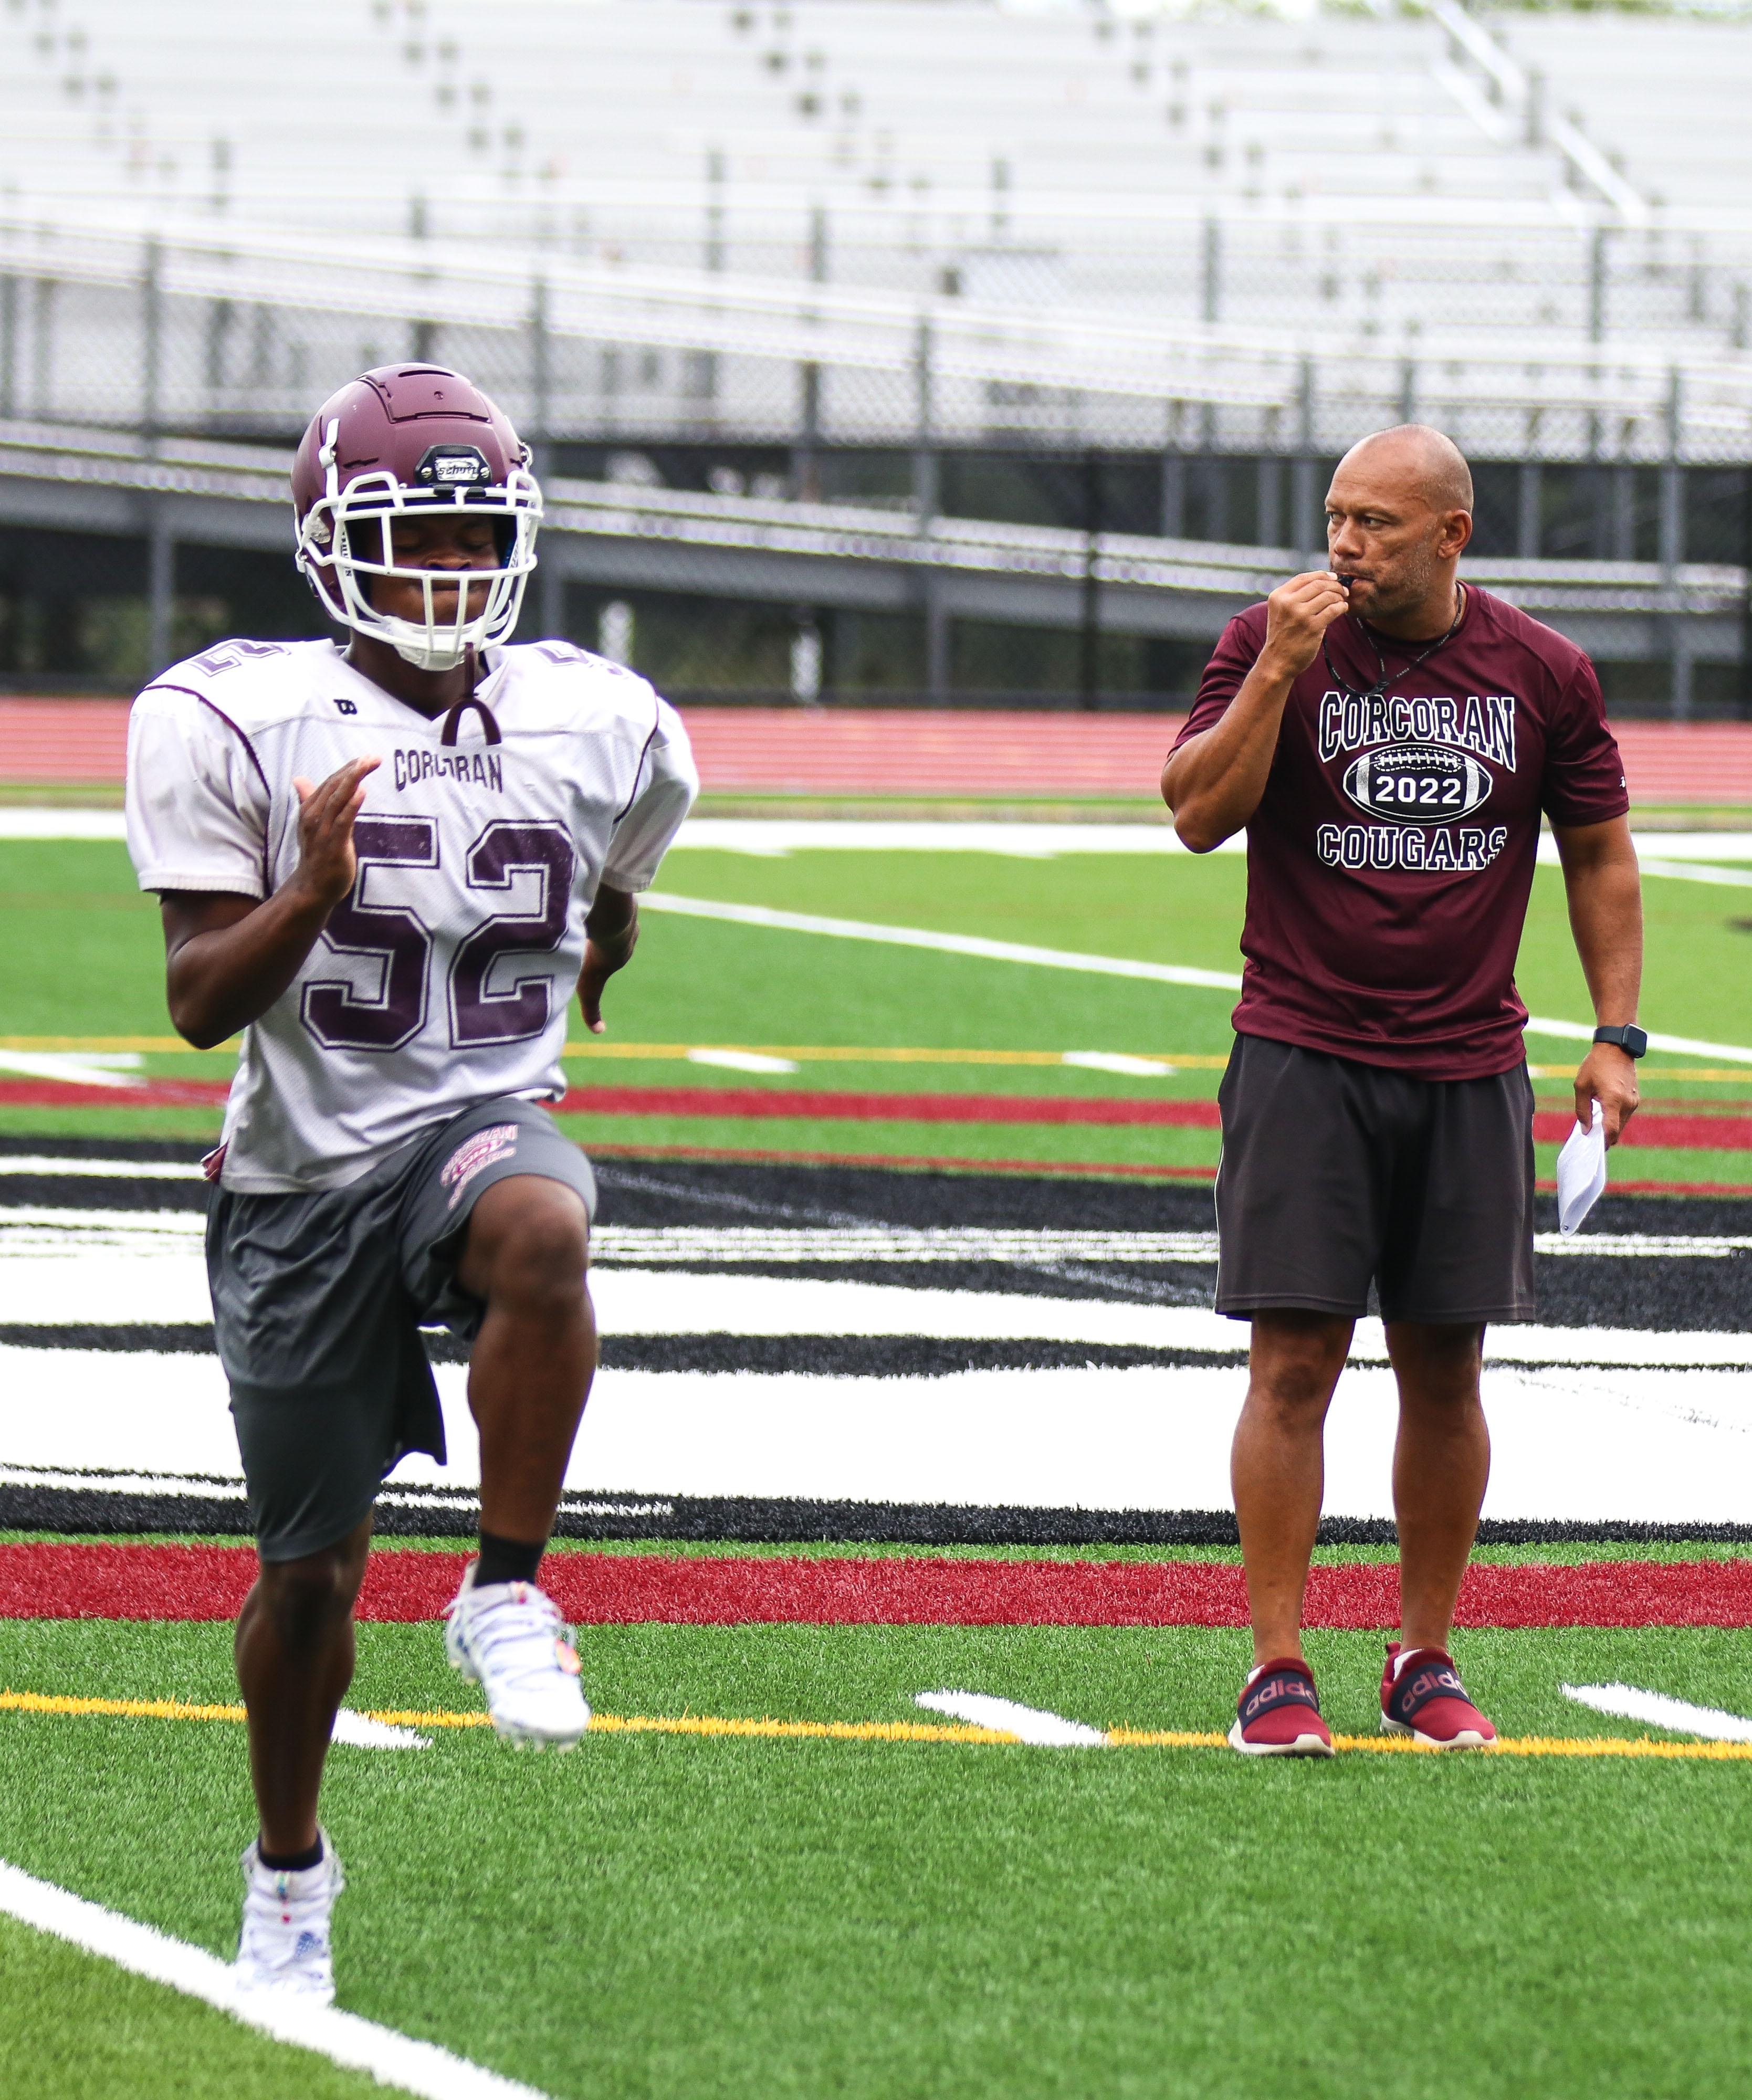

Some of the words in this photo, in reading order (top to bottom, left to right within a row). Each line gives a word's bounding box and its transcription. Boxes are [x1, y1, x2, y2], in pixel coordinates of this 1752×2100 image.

[1318, 691, 1516, 773] CORCORAN
[1375, 775, 1461, 804] 2022
[1317, 824, 1508, 871] COUGARS
[300, 813, 578, 1051] 52
